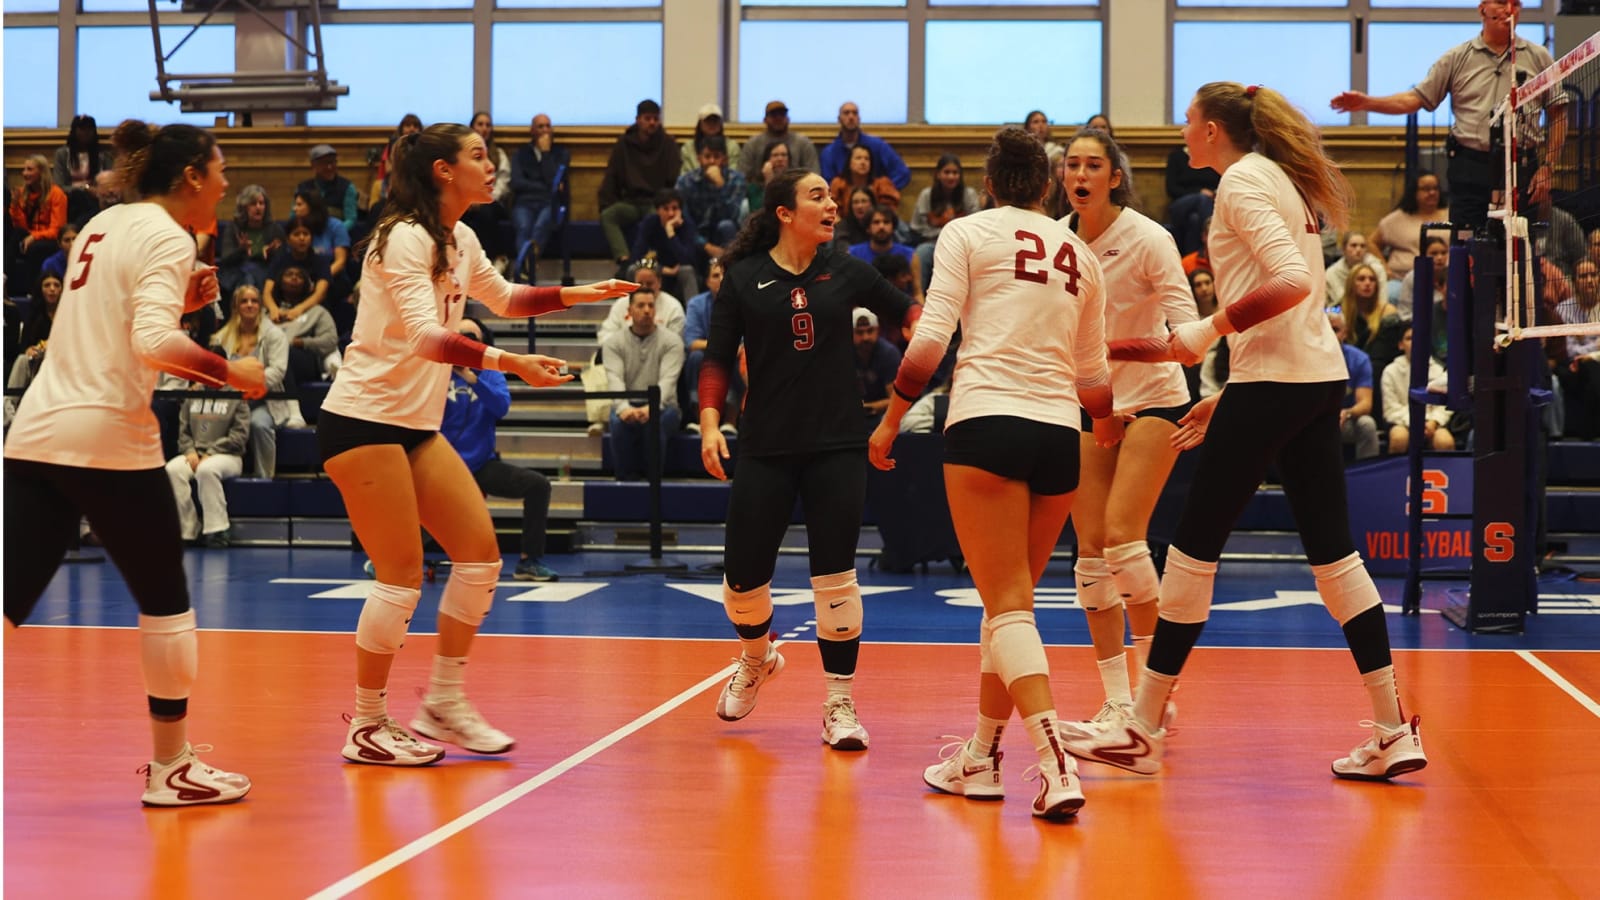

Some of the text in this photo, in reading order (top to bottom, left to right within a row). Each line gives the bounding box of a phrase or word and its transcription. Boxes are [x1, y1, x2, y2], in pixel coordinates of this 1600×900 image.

[70, 233, 106, 291] 5
[1014, 229, 1081, 297] 24
[791, 312, 815, 351] 9
[1405, 469, 1449, 518] S
[1483, 521, 1515, 562] S
